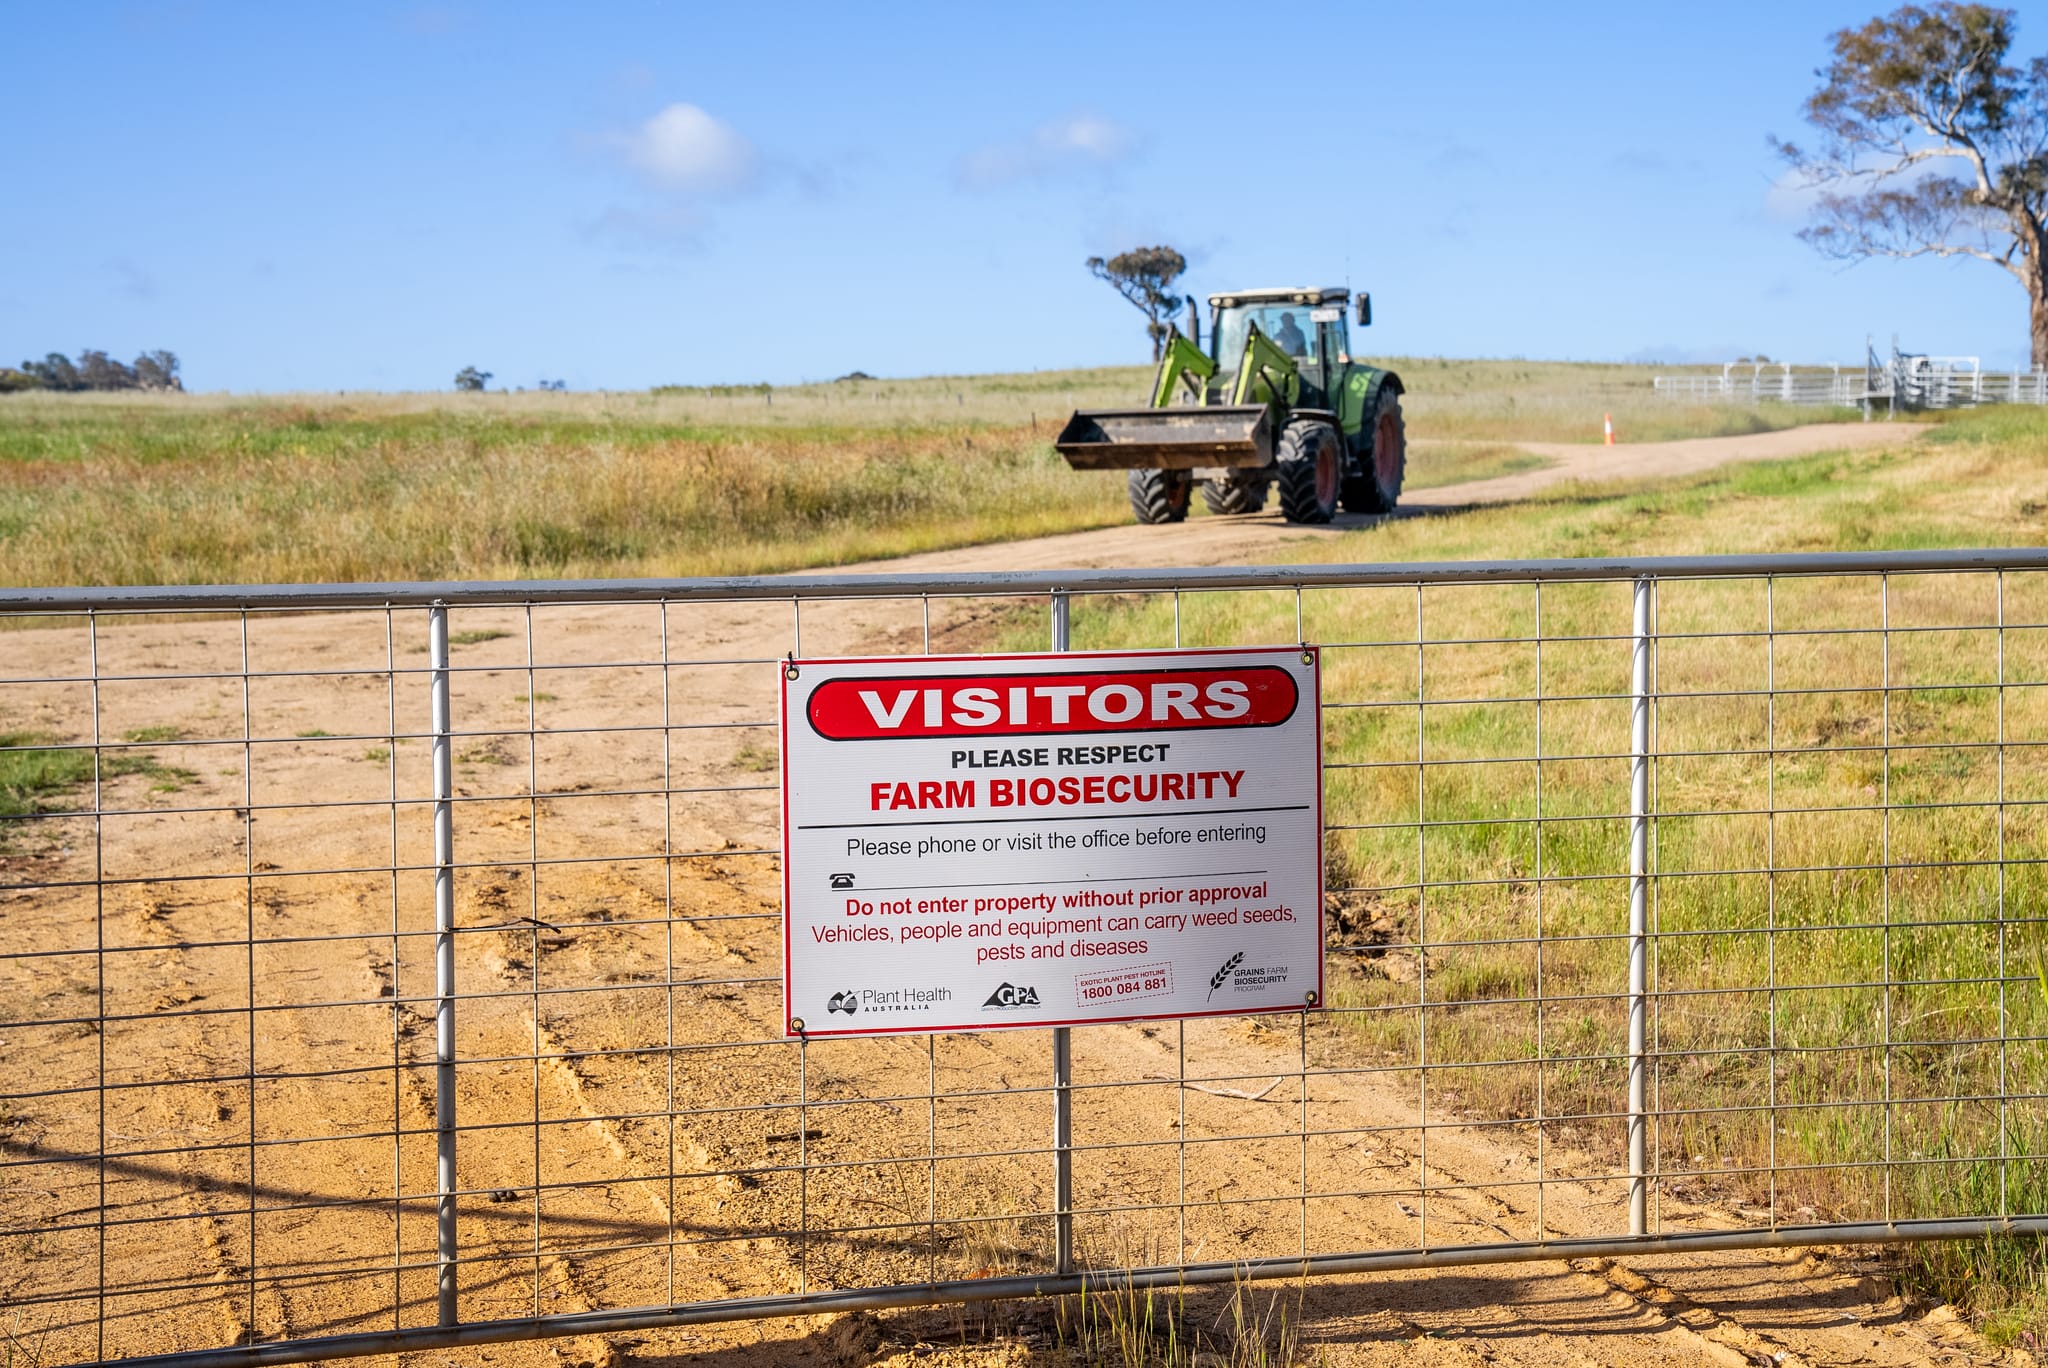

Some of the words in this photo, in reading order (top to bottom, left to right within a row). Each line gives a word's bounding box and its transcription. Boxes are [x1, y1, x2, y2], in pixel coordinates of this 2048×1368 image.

[858, 680, 1250, 729] VISITORS
[952, 748, 1049, 768] PLEASE
[1058, 744, 1170, 765] RESPECT
[871, 781, 975, 810] FARM
[989, 770, 1245, 808] BIOSECURITY
[848, 839, 911, 856] Please
[919, 836, 976, 858] phone
[983, 839, 1001, 851] or
[1007, 833, 1042, 850] visit
[1048, 832, 1076, 849] the
[1082, 830, 1129, 847] office
[1136, 827, 1191, 845] before
[1197, 823, 1265, 844] entering
[847, 899, 873, 916] Do
[881, 898, 912, 914] not
[918, 897, 968, 913] enter
[975, 893, 1056, 915] property
[1063, 889, 1134, 907] without
[1140, 887, 1183, 908] prior
[1189, 881, 1266, 905] approval
[812, 924, 893, 943] Vehicles,
[901, 921, 962, 944] people
[968, 919, 1001, 937] and
[1008, 916, 1102, 939] equipment
[1108, 917, 1138, 931] can
[1145, 915, 1187, 932] carry
[1192, 907, 1237, 926] weed
[1243, 905, 1296, 923] seeds,
[978, 944, 1025, 965] pests
[1031, 940, 1064, 958] and
[1071, 939, 1148, 957] diseases
[1081, 978, 1102, 986] EXOTIC
[1103, 975, 1123, 983] PLANT
[1124, 972, 1139, 980] PEST
[1140, 969, 1166, 978] HOTLINE
[1234, 968, 1265, 977] GRAINS
[1266, 966, 1288, 975] FARM
[1234, 975, 1287, 985] BIOSECURITY
[863, 990, 899, 1003] Plant
[905, 987, 951, 1002] Health
[997, 986, 1040, 1004] GPA
[1082, 985, 1112, 999] 1800
[1117, 981, 1140, 995] 084
[1144, 977, 1166, 990] 881
[864, 1004, 930, 1012] AUSTRALIA
